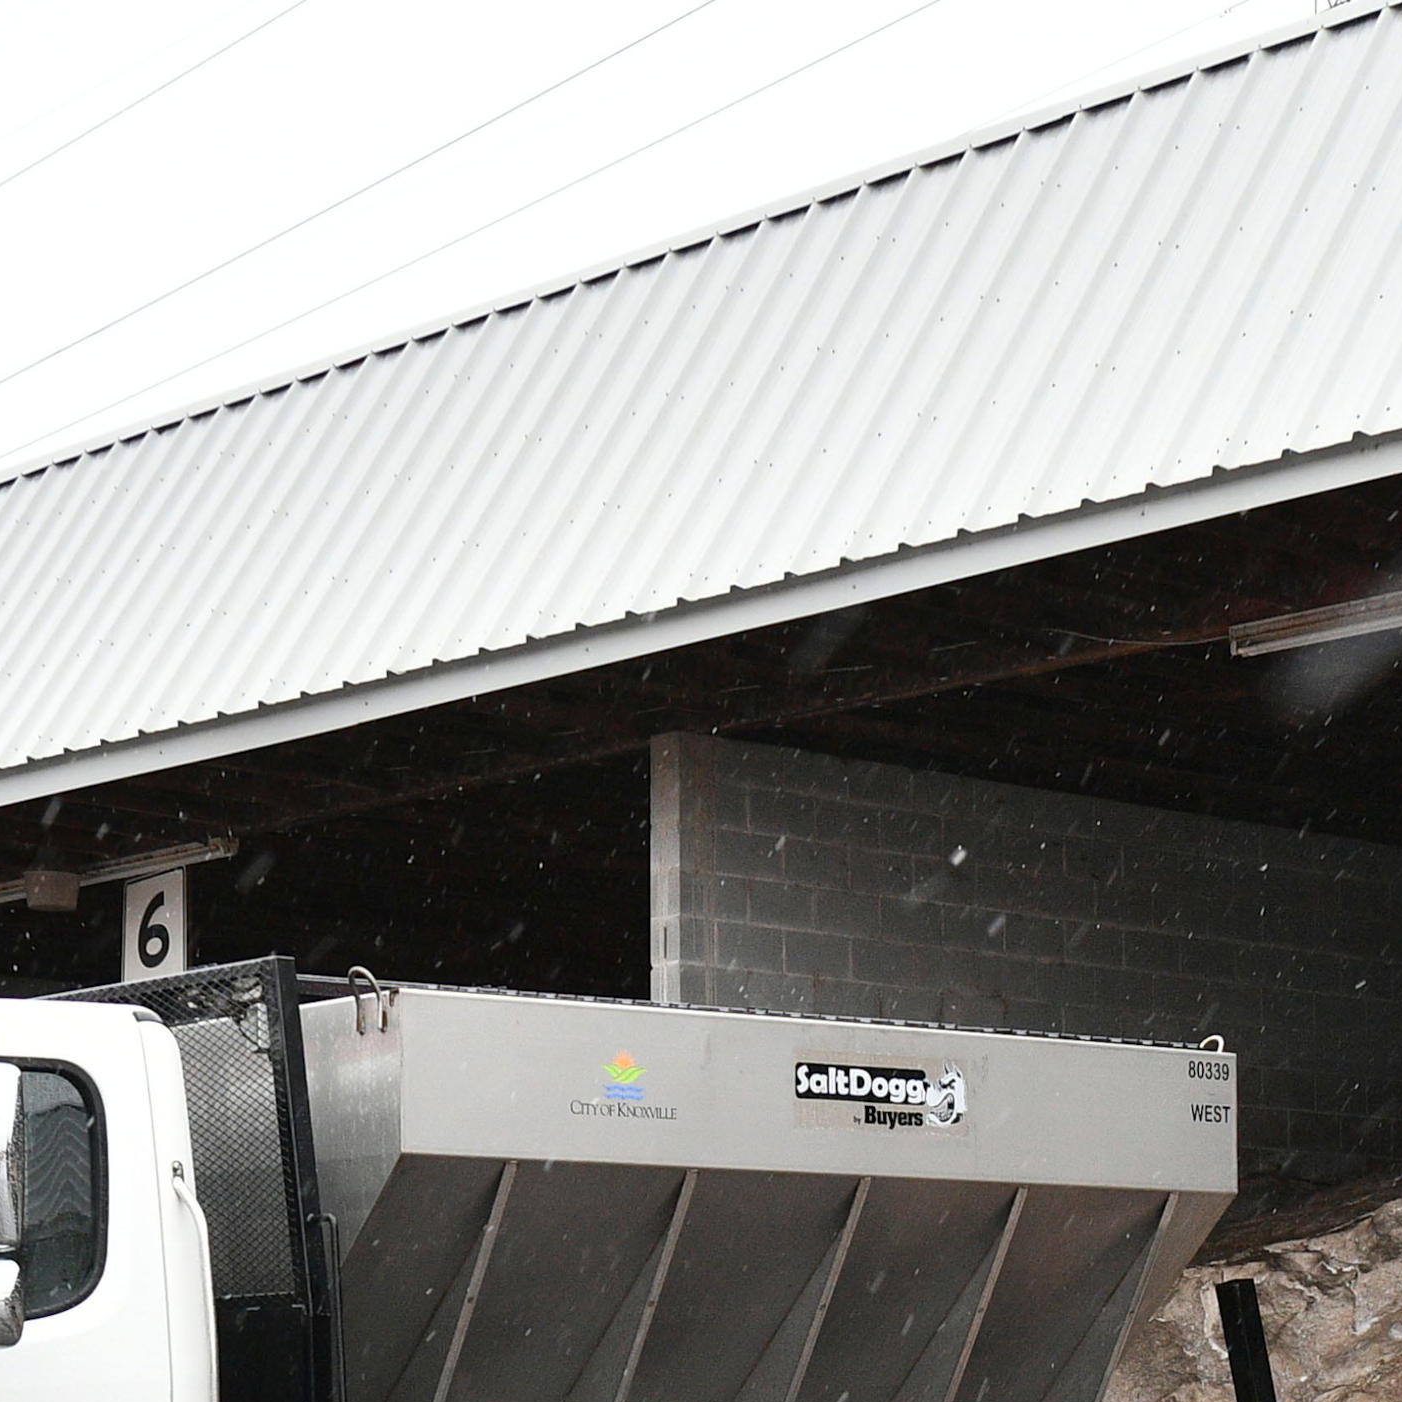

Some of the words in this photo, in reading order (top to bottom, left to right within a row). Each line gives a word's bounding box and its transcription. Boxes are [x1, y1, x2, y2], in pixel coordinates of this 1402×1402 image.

[138, 891, 169, 968] 6
[1188, 1060, 1230, 1081] 80339
[796, 1064, 926, 1104] SaltDogg
[617, 1102, 677, 1120] KNOXVILLE
[864, 1105, 923, 1130] Buyers
[1191, 1103, 1231, 1123] WEST
